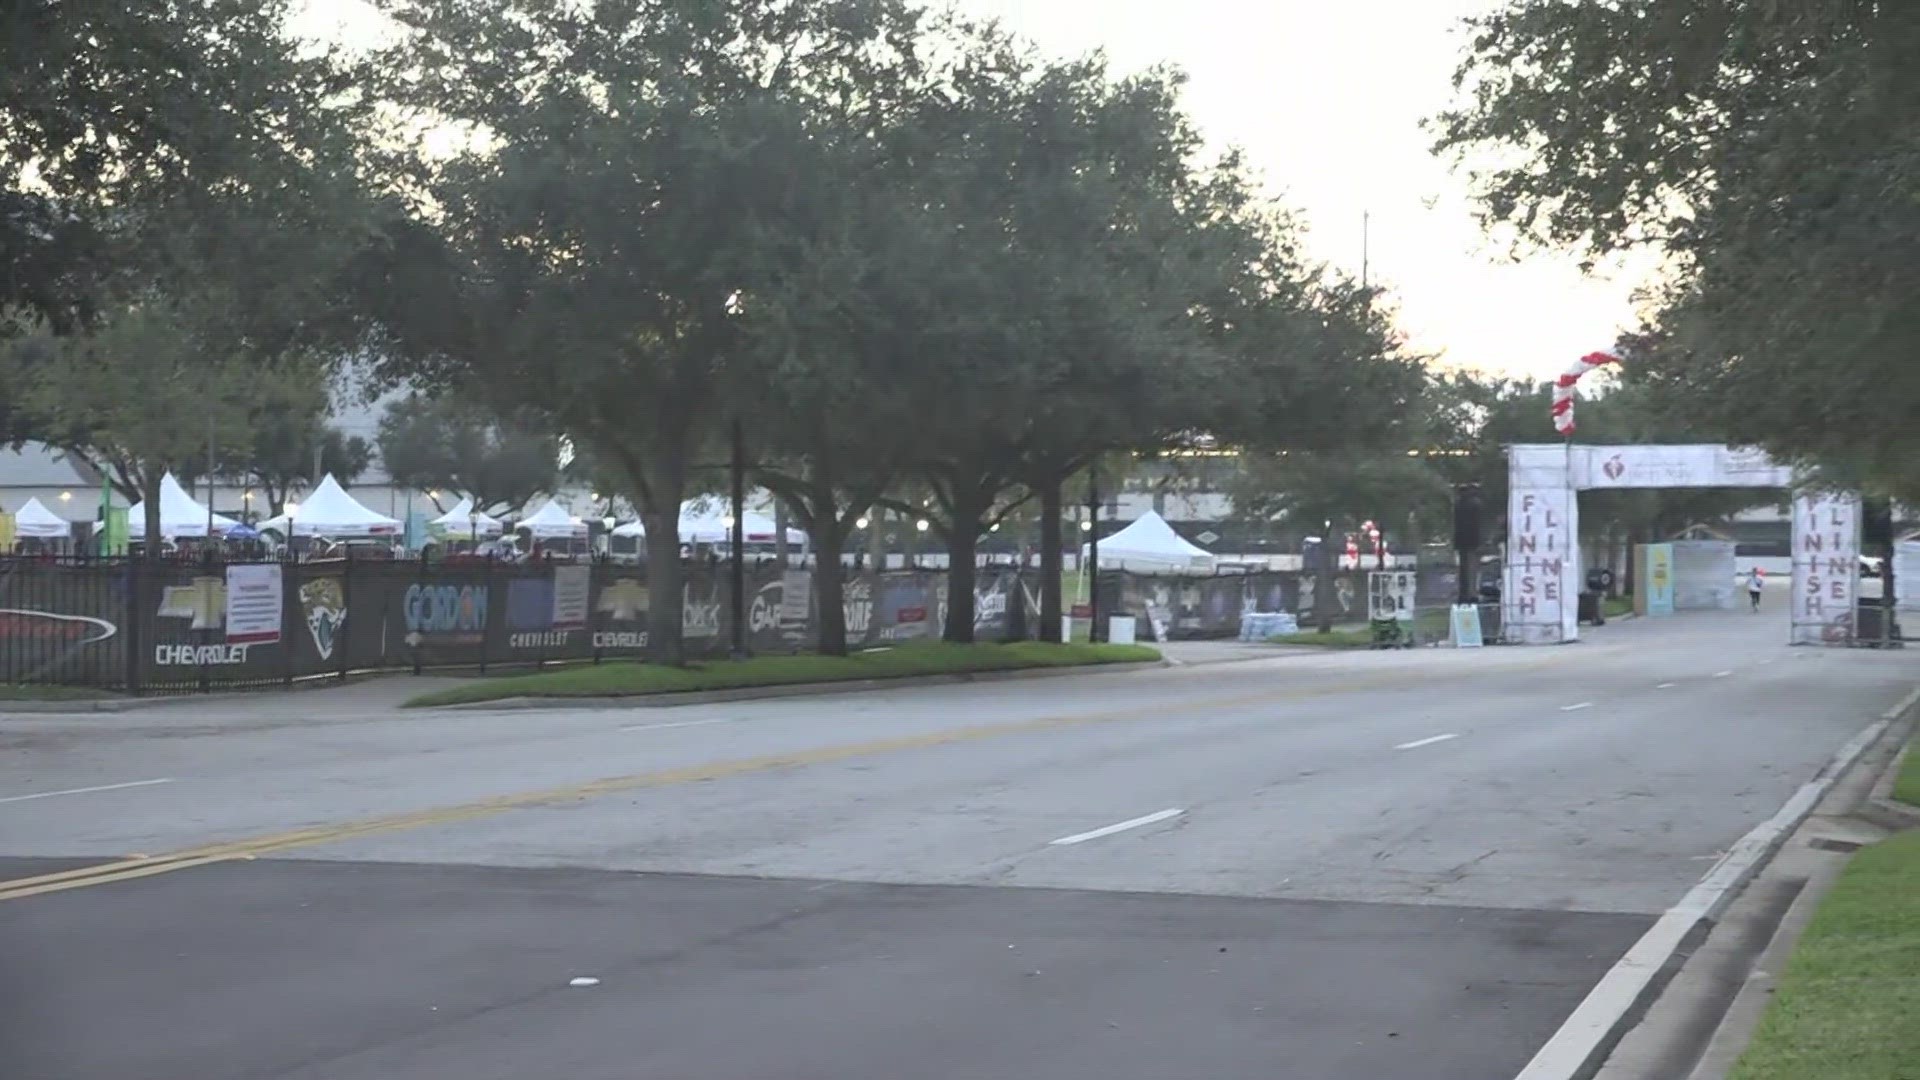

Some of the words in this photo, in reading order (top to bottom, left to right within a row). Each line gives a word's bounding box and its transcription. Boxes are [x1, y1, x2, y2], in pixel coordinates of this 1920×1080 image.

[1520, 495, 1536, 616] FINISH
[1541, 509, 1563, 601] LINE
[1828, 507, 1846, 599] LINE
[403, 583, 489, 632] GORDON
[155, 643, 249, 666] CHEVROLET
